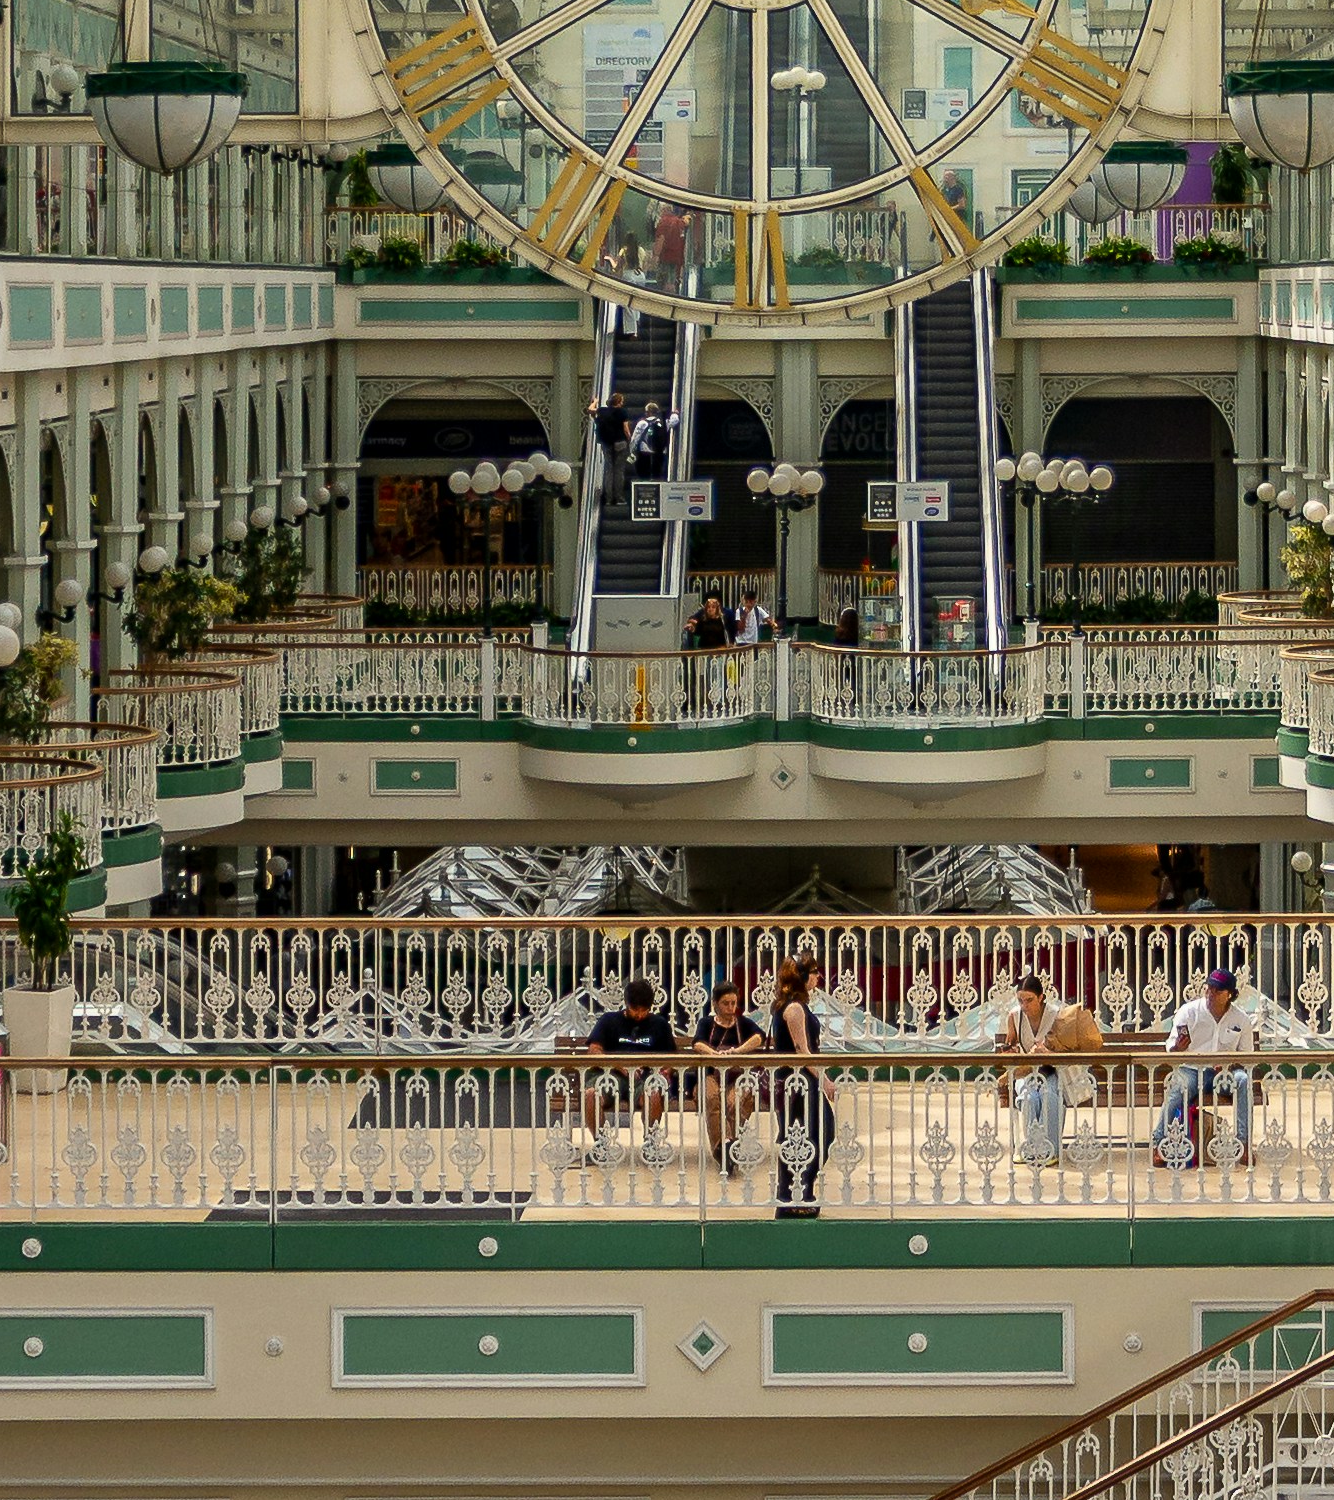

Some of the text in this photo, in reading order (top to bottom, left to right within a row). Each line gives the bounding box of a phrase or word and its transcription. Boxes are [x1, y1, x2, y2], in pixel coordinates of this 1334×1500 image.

[386, 12, 511, 148] VIII
[595, 56, 652, 67] DIRECTORY
[527, 152, 628, 275] VII
